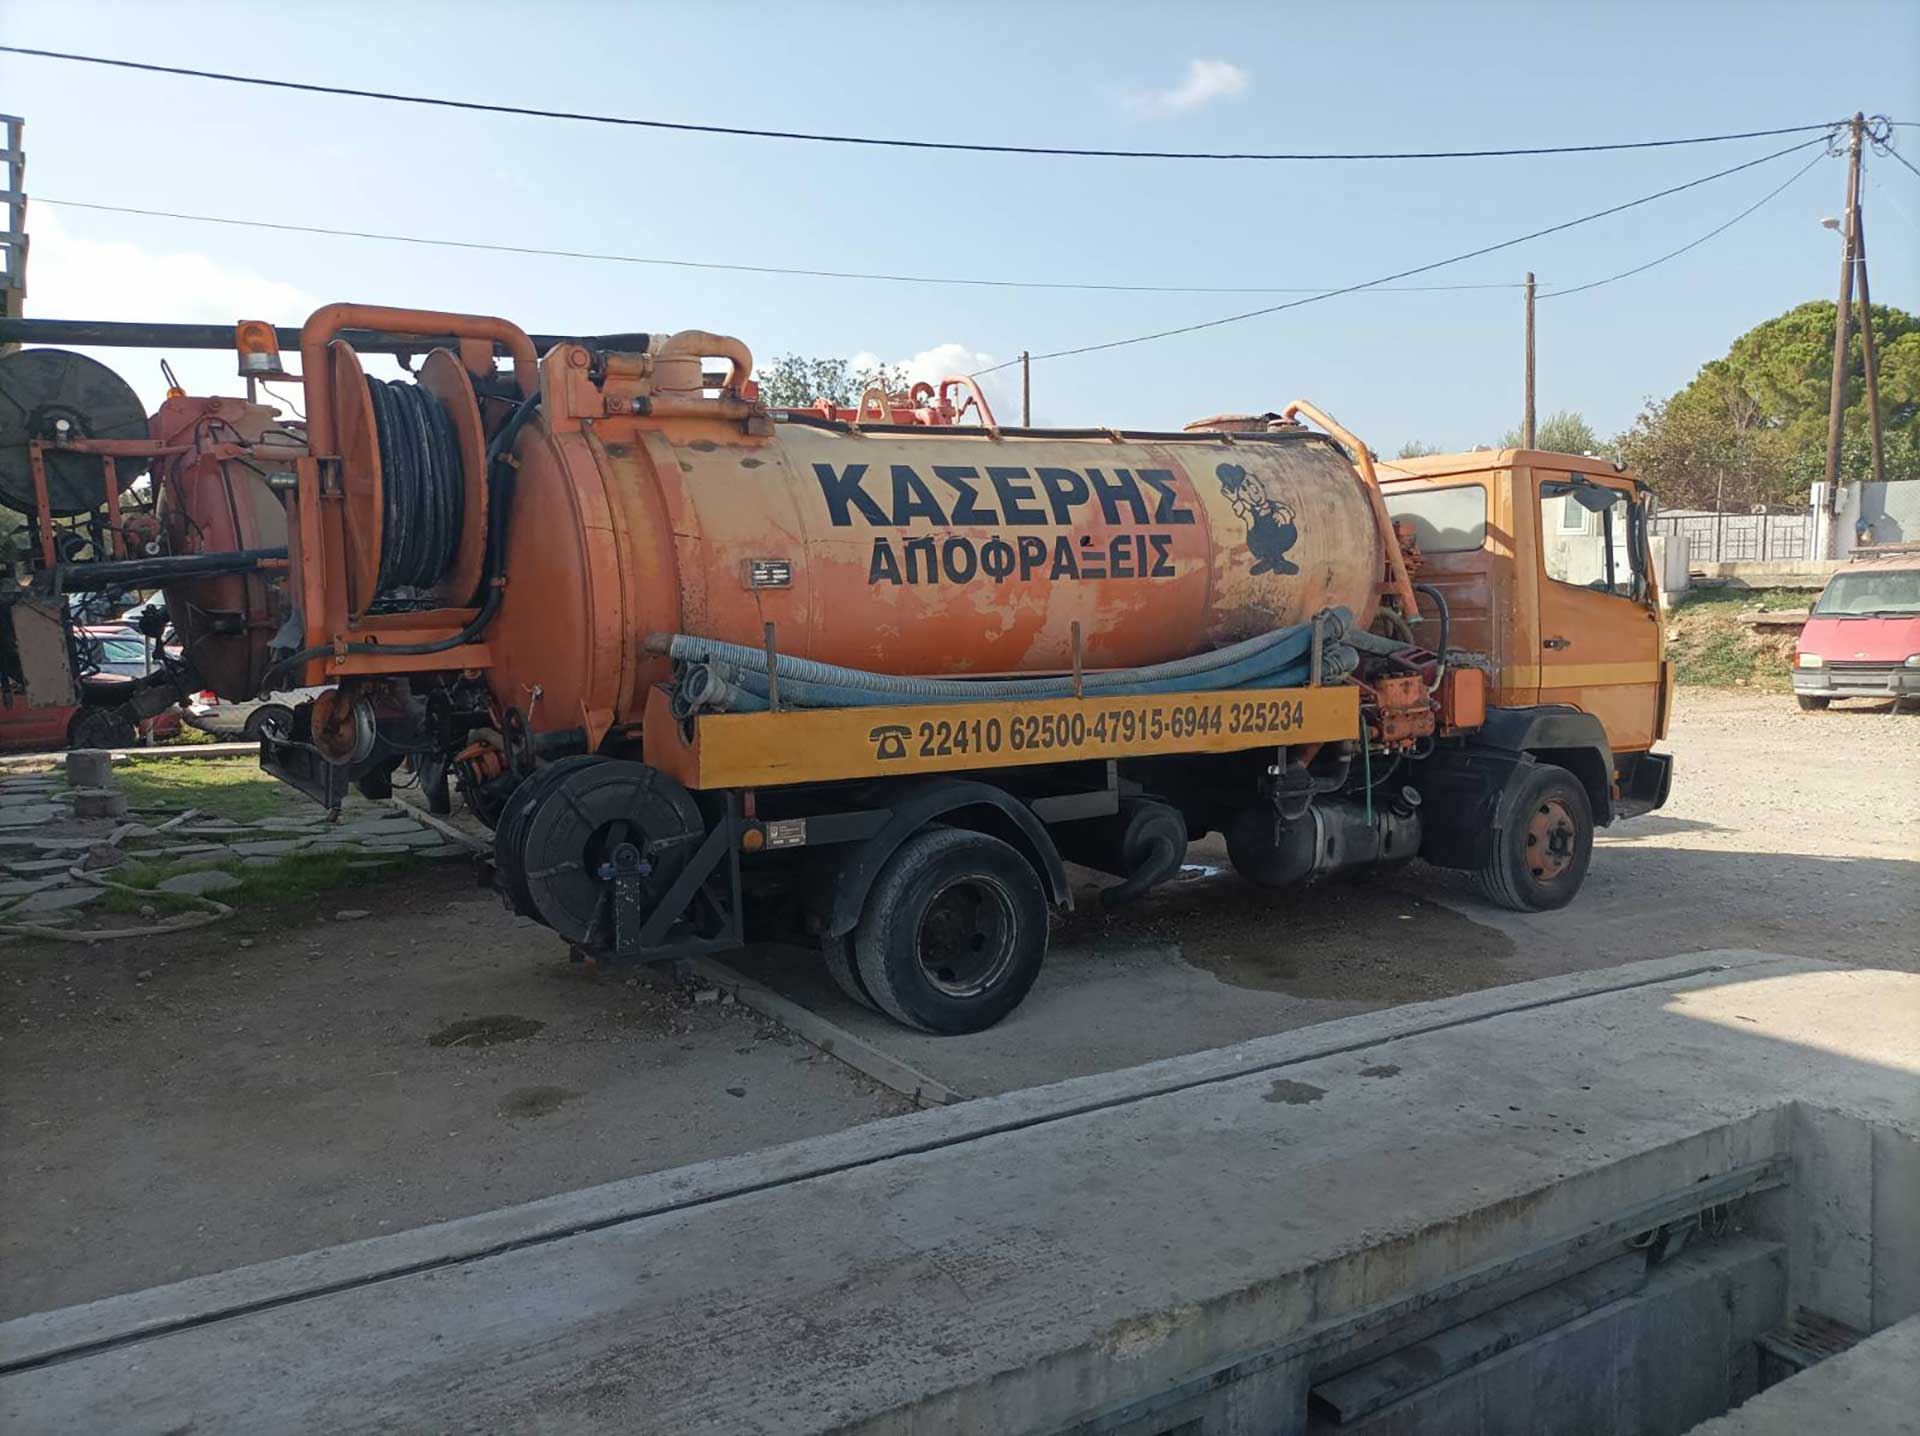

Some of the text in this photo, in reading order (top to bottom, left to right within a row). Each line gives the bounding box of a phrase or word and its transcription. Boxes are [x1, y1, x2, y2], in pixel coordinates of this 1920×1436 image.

[812, 463, 1196, 527] ΚΑΣΕΡΗΣ
[868, 534, 1176, 586] ΑΠΟΦΡΑΞΕΙΣ
[918, 719, 1002, 757] 22410
[1228, 700, 1304, 734] 325234
